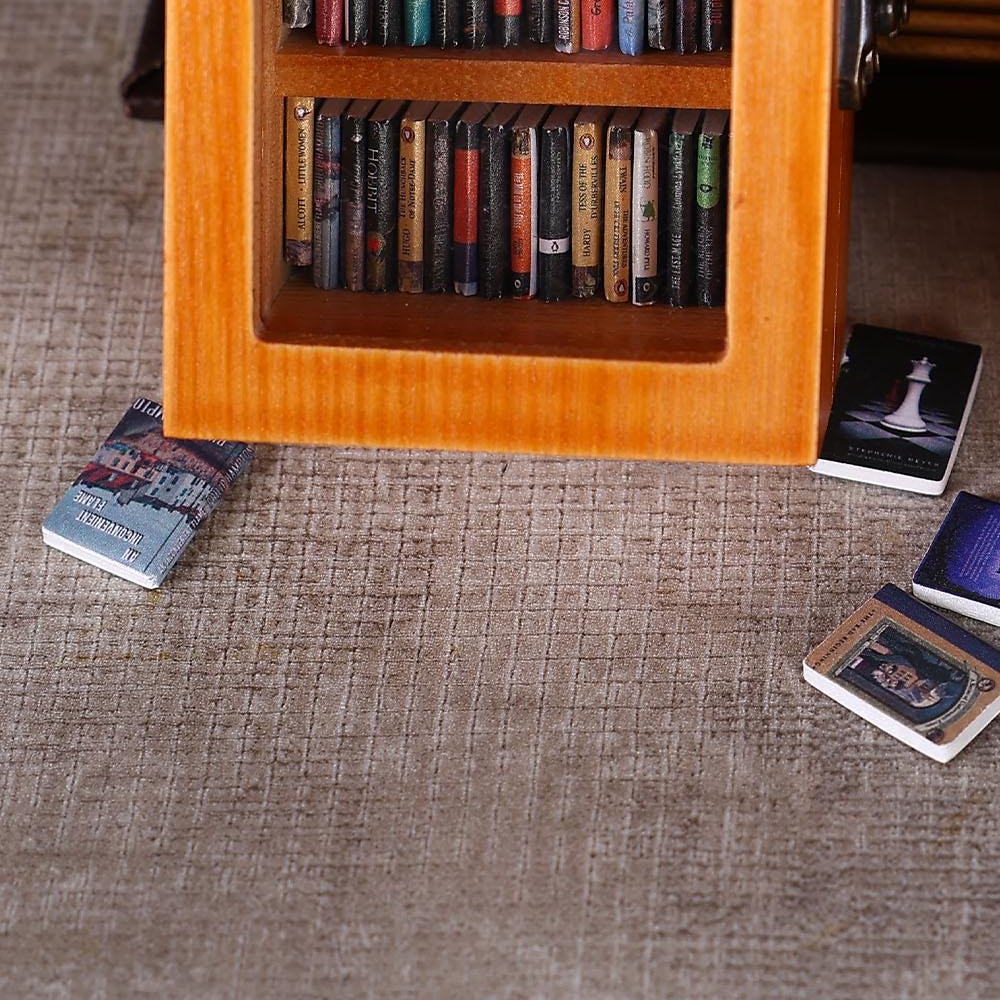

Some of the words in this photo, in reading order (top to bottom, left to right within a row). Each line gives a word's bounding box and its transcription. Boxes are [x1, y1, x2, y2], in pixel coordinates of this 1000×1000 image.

[558, 7, 569, 40] ROBINSON
[298, 128, 306, 159] WOMEN
[298, 159, 306, 184] LITTLE
[367, 148, 379, 215] HOBBIT
[408, 159, 416, 208] NOTRE-DAME
[578, 164, 586, 179] THE
[619, 167, 627, 193] TWAIN
[579, 180, 586, 191] OF
[402, 229, 410, 256] HUGO
[583, 228, 591, 257] HARDY
[672, 234, 681, 252] MAGE
[672, 255, 681, 274] LAST
[672, 276, 681, 289] THE
[74, 490, 105, 513] FLAME
[75, 509, 144, 546] INCONVENIENT
[121, 547, 142, 563] AN
[862, 611, 873, 623] THE
[816, 637, 847, 666] BEGINNING
